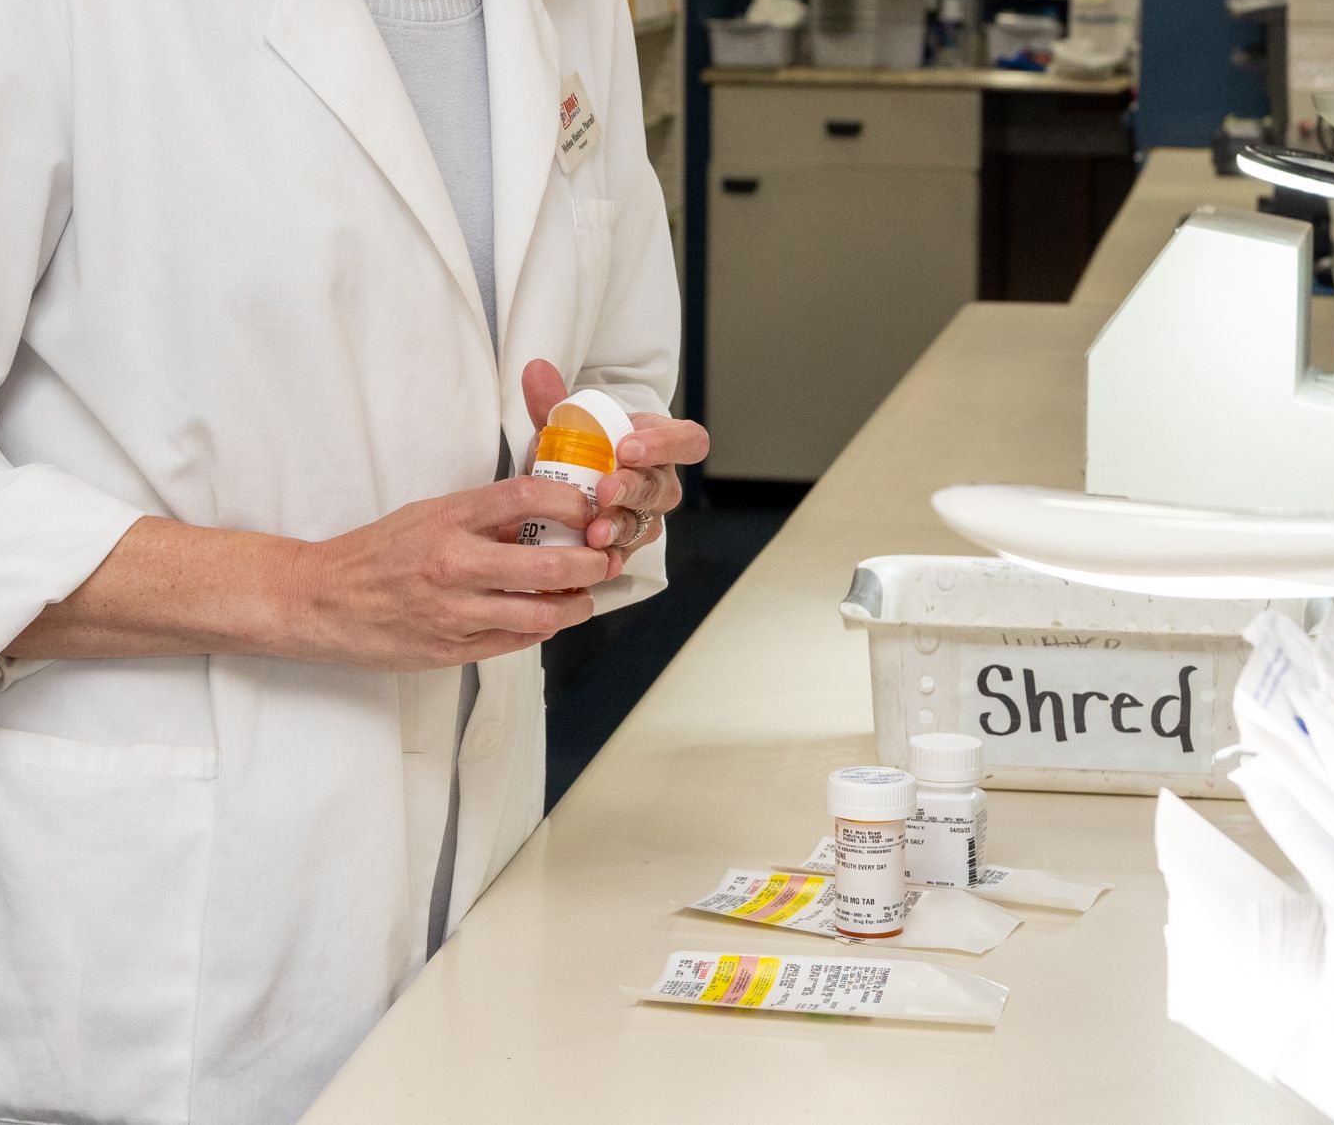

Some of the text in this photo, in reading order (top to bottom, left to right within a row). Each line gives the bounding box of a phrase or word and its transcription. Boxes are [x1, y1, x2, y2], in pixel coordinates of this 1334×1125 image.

[977, 664, 1198, 753] Shred
[841, 861, 857, 870] MOUTH
[850, 897, 860, 905] MG
